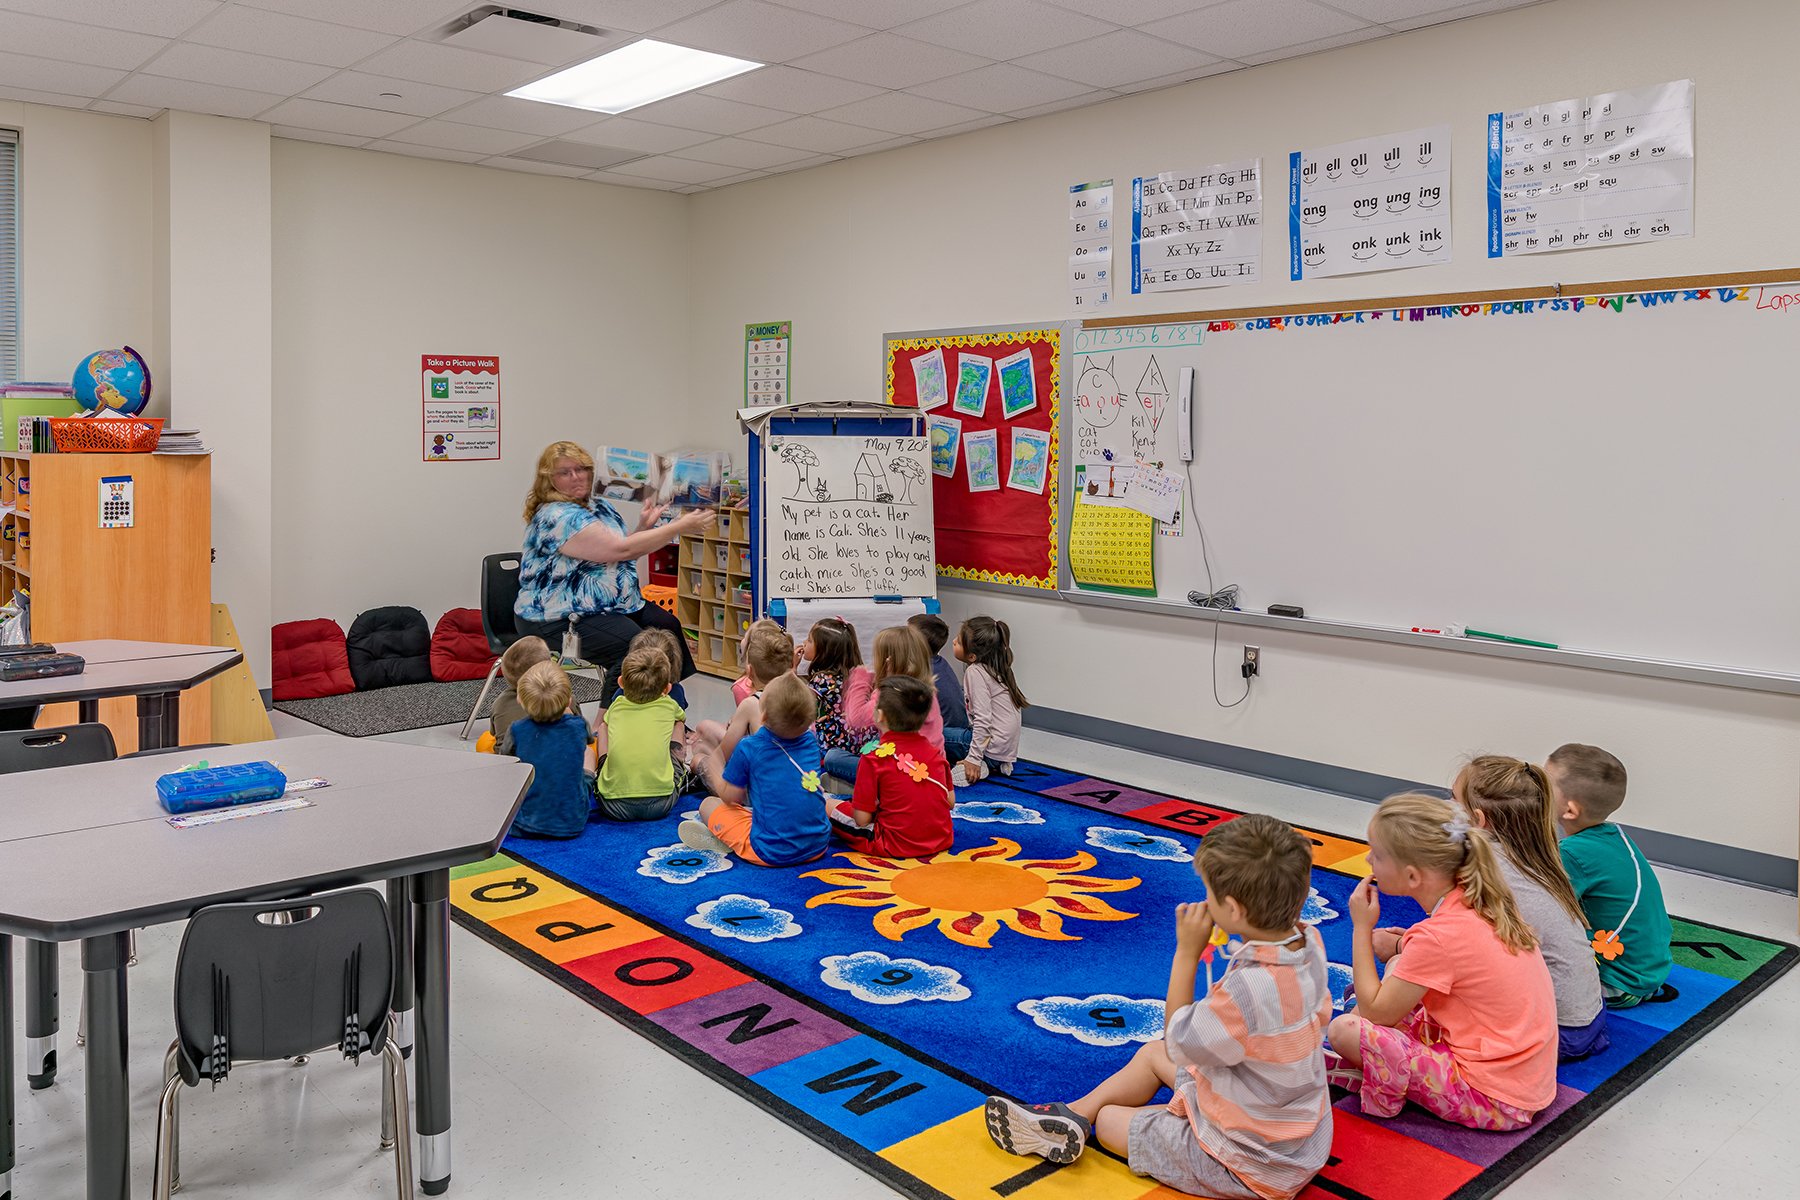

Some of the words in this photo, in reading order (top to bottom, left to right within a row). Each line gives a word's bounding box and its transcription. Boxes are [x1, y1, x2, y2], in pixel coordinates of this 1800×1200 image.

[1506, 120, 1513, 129] bl
[1524, 118, 1532, 126] cl
[1543, 114, 1550, 122] fl
[1561, 111, 1570, 121] gl
[1583, 108, 1592, 119] pl
[1603, 104, 1611, 113] sl
[1491, 120, 1500, 150] Blends
[1505, 145, 1515, 153] br
[1543, 139, 1553, 147] dr
[1562, 135, 1572, 143] fr
[1584, 133, 1594, 143] gr
[1604, 129, 1615, 139] pr
[1626, 125, 1635, 134] tr
[1303, 163, 1317, 176] all
[1326, 158, 1340, 171] ell
[1351, 153, 1367, 167] oll
[1384, 147, 1400, 161] ull
[1420, 142, 1431, 156] ill
[1524, 165, 1534, 173] sk
[1543, 162, 1551, 170] sl
[1609, 153, 1620, 162] sp
[1630, 148, 1640, 157] st
[1651, 146, 1666, 154] sw
[1143, 185, 1155, 196] Bb
[1159, 182, 1173, 193] Cc
[1179, 179, 1194, 191] Dd
[1200, 175, 1212, 188] Ff
[1219, 173, 1234, 186] Gg
[1241, 169, 1256, 182] Hh
[1504, 191, 1518, 199] scr
[1526, 188, 1542, 197] spr
[1574, 180, 1589, 190] spl
[1599, 177, 1617, 187] squ
[1075, 200, 1087, 208] Aa
[1143, 205, 1153, 218] Jj
[1157, 202, 1169, 214] Kk
[1215, 194, 1230, 206] Nn
[1237, 192, 1252, 204] Pp
[1303, 205, 1326, 217] ang
[1354, 197, 1378, 210] ong
[1386, 191, 1411, 205] ung
[1419, 186, 1441, 200] ing
[1075, 224, 1086, 232] Ee
[1142, 227, 1155, 239] Qq
[1161, 224, 1171, 236] Rr
[1178, 222, 1191, 233] Ss
[1199, 219, 1210, 230] Tt
[1218, 217, 1231, 228] Vv
[1237, 214, 1256, 226] Ww
[1504, 215, 1517, 223] dw
[1526, 212, 1537, 220] tw
[1304, 243, 1325, 257] ank
[1352, 237, 1377, 250] onk
[1386, 232, 1411, 246] unk
[1420, 228, 1442, 242] ink
[1505, 241, 1519, 249] shr
[1526, 237, 1539, 246] thr
[1549, 235, 1563, 246] phl
[1573, 233, 1589, 244] phr
[1598, 229, 1613, 239] chl
[1624, 227, 1640, 236] chr
[1651, 224, 1669, 233] sch
[1075, 247, 1088, 256] Oo
[1167, 245, 1181, 257] Xx
[1186, 243, 1200, 256] Yy
[1207, 241, 1221, 253] Zz
[1074, 272, 1086, 280] Uu
[1143, 273, 1156, 284] Aa
[1164, 271, 1177, 282] Ee
[1186, 268, 1201, 279] Oo
[1211, 266, 1226, 277] Uu
[755, 325, 780, 336] MONEY
[427, 358, 444, 366] Take
[452, 359, 476, 367] Picture
[864, 438, 891, 456] May
[781, 504, 798, 525] My
[804, 506, 822, 524] pet
[829, 508, 838, 519] is
[842, 509, 852, 519] a
[856, 506, 881, 519] cat.
[887, 506, 910, 521] Her
[784, 529, 811, 541] name
[816, 526, 825, 539] is
[829, 523, 852, 537] Cali.
[857, 522, 887, 538] She's
[908, 531, 931, 544] years
[808, 544, 829, 560] She
[835, 542, 860, 558] loves
[866, 544, 880, 558] to
[885, 545, 910, 564] play
[913, 550, 930, 562] and
[817, 568, 843, 579] mice
[850, 562, 879, 579] She's
[885, 566, 895, 576] a
[901, 564, 927, 581] good
[780, 583, 800, 593] cat!
[807, 580, 831, 593] She's
[835, 581, 856, 593] also
[865, 578, 899, 594] fluffy.
[1070, 789, 1122, 805] A
[1163, 808, 1222, 827] B
[666, 857, 704, 867] 8
[470, 877, 539, 903] Q
[536, 921, 616, 943] P
[614, 956, 695, 987] O
[699, 1001, 801, 1047] N
[1087, 1006, 1126, 1029] 5
[804, 1057, 927, 1117] M
